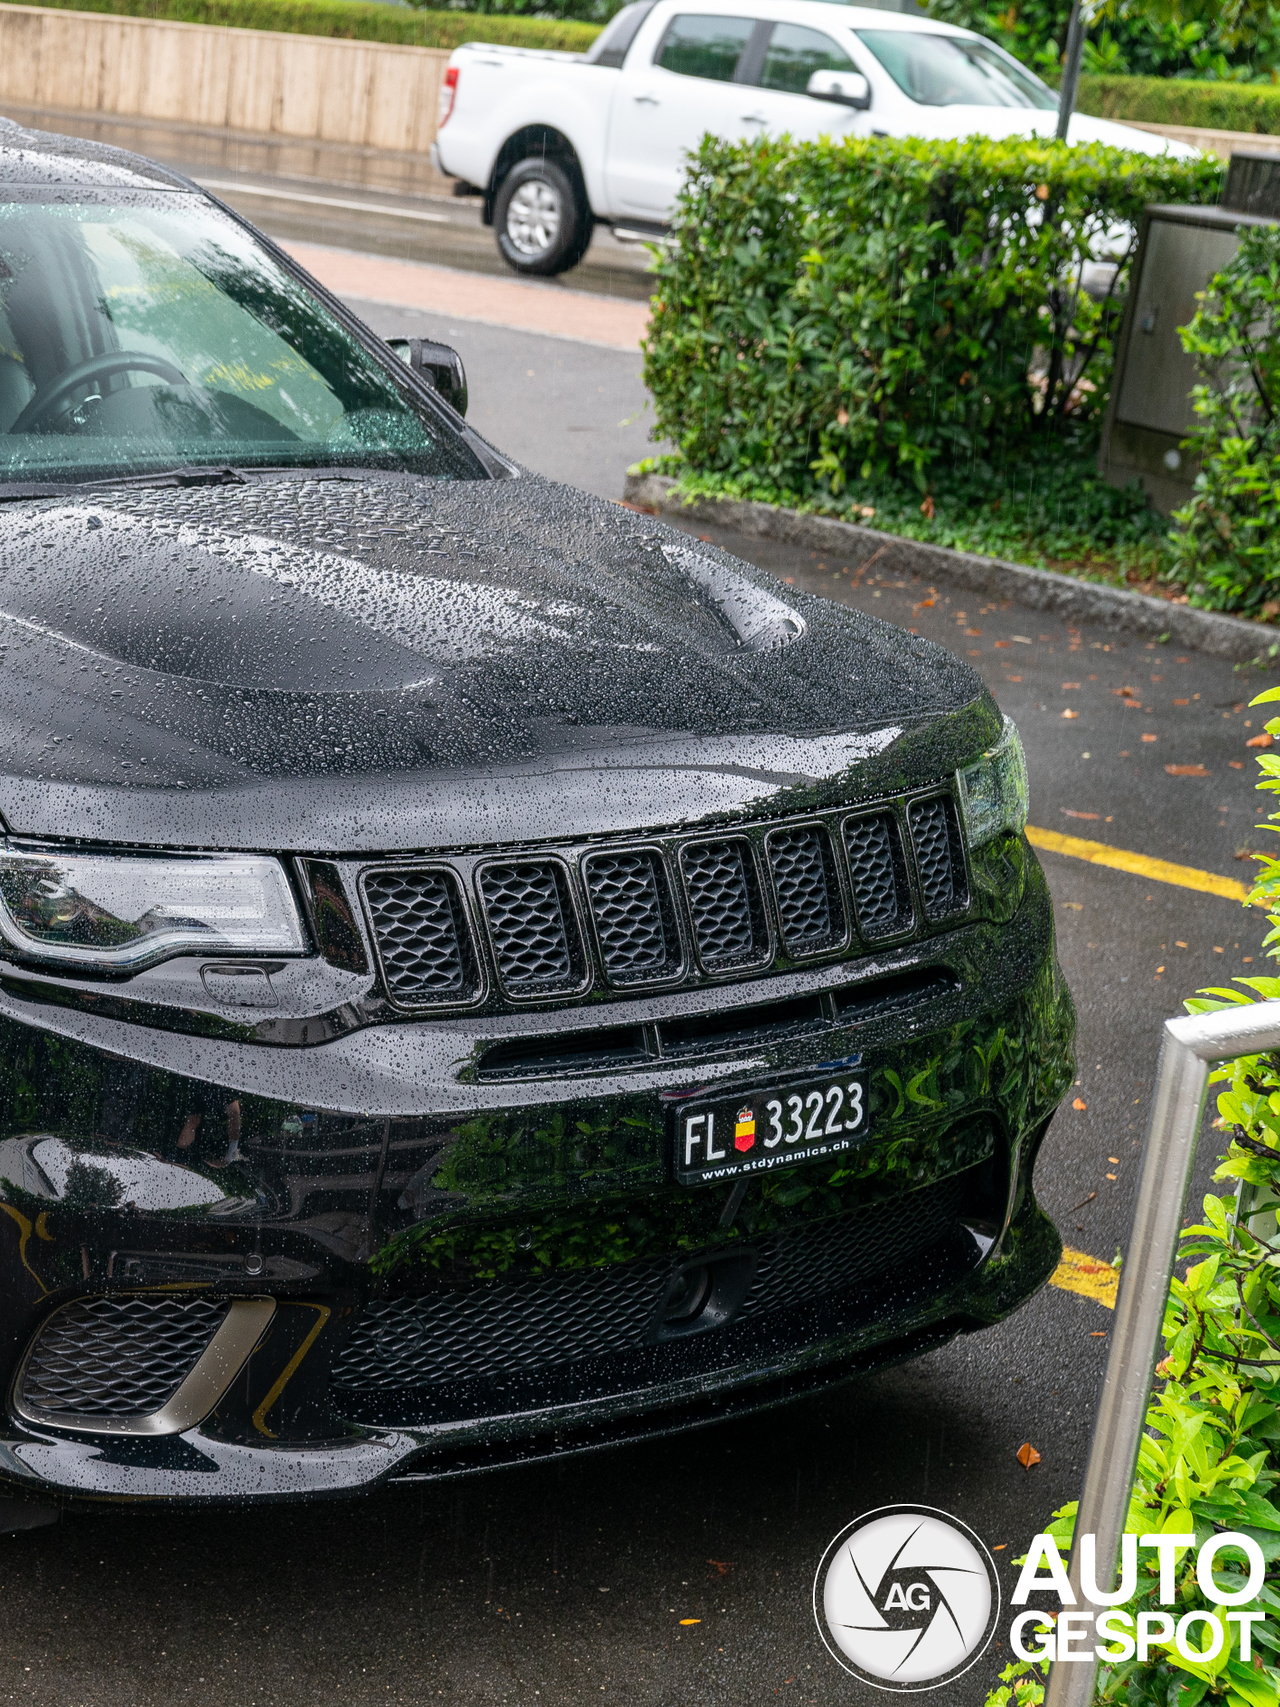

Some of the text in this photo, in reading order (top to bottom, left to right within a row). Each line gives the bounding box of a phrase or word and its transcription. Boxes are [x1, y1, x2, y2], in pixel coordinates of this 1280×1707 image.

[685, 1082, 863, 1165] FL 33223
[701, 1140, 850, 1180] www.stdynamics.ch
